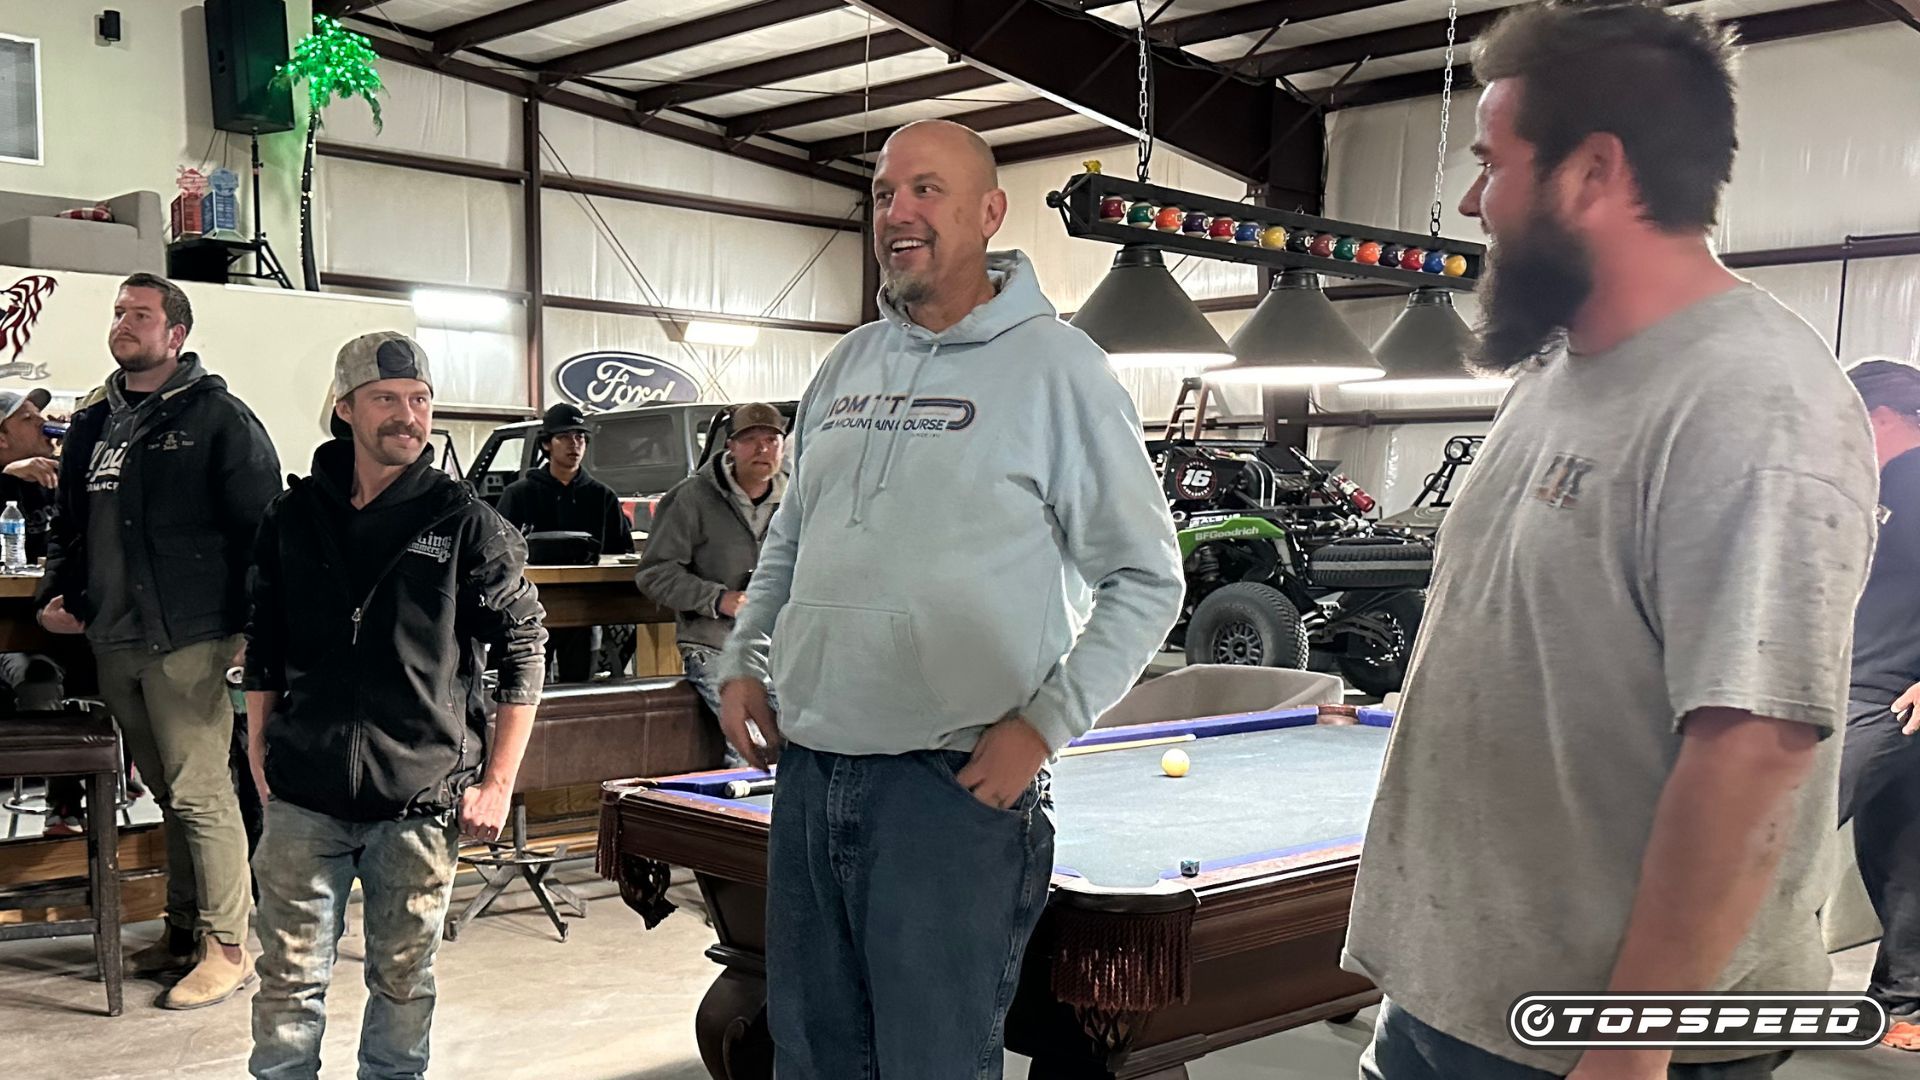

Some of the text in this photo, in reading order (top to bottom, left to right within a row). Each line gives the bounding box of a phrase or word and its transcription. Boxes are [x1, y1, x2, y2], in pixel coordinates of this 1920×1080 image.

[587, 361, 676, 405] Ford
[1181, 469, 1212, 487] 16
[1195, 526, 1259, 541] BFGoodrich
